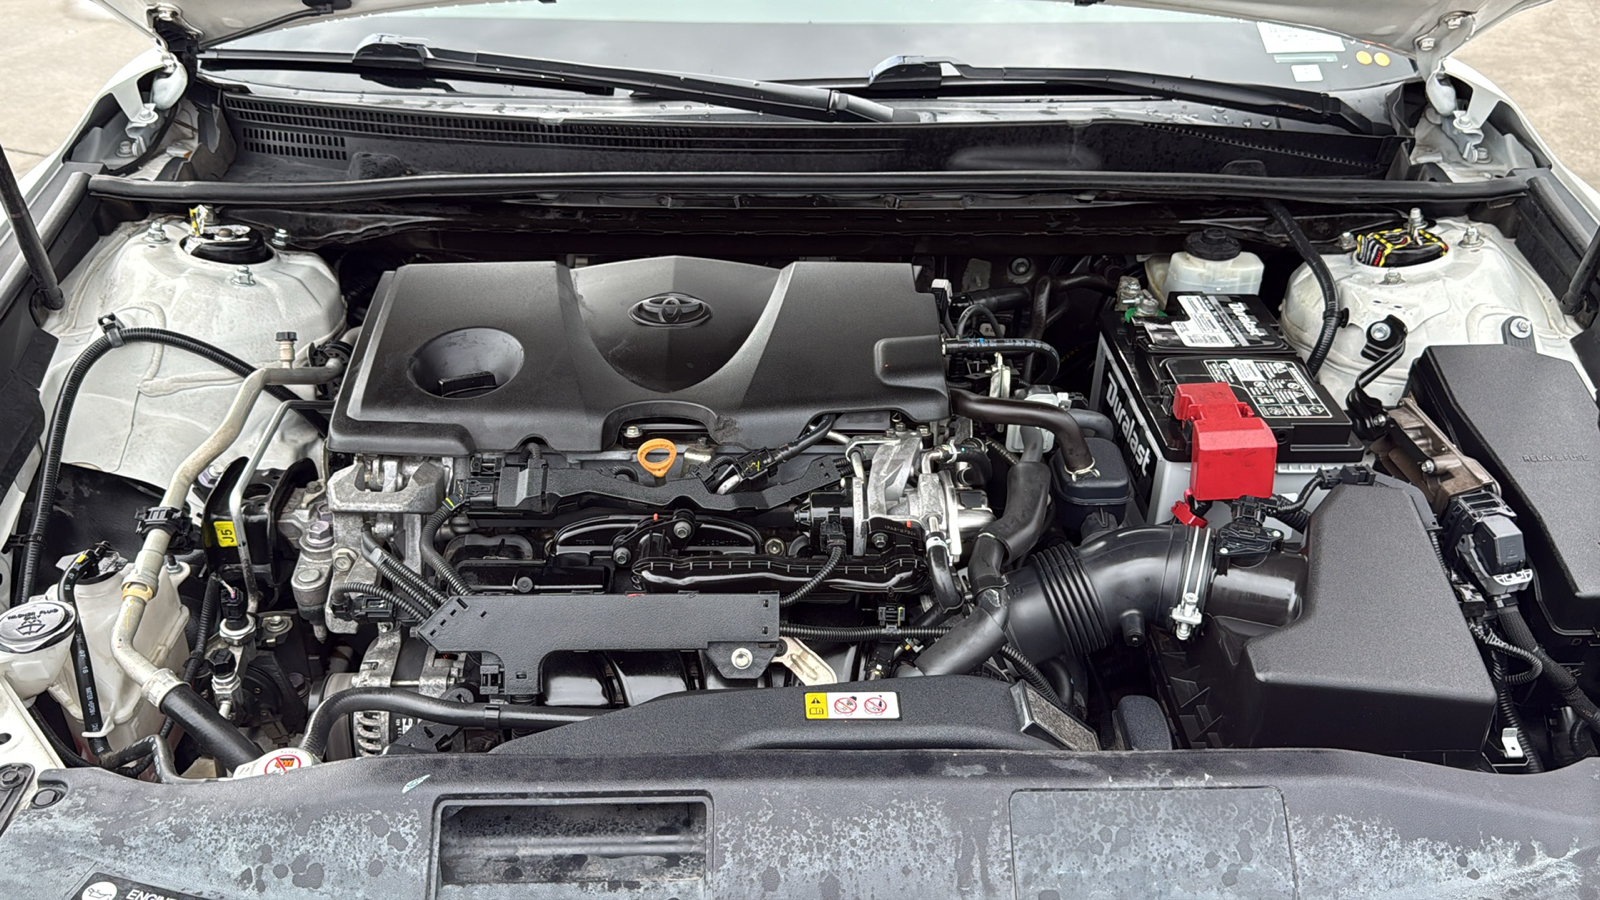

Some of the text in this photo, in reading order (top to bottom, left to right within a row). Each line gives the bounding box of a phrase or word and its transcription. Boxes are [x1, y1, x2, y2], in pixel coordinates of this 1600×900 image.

[1228, 302, 1267, 337] Duralast
[1106, 371, 1150, 477] Duralast
[220, 529, 235, 543] J5
